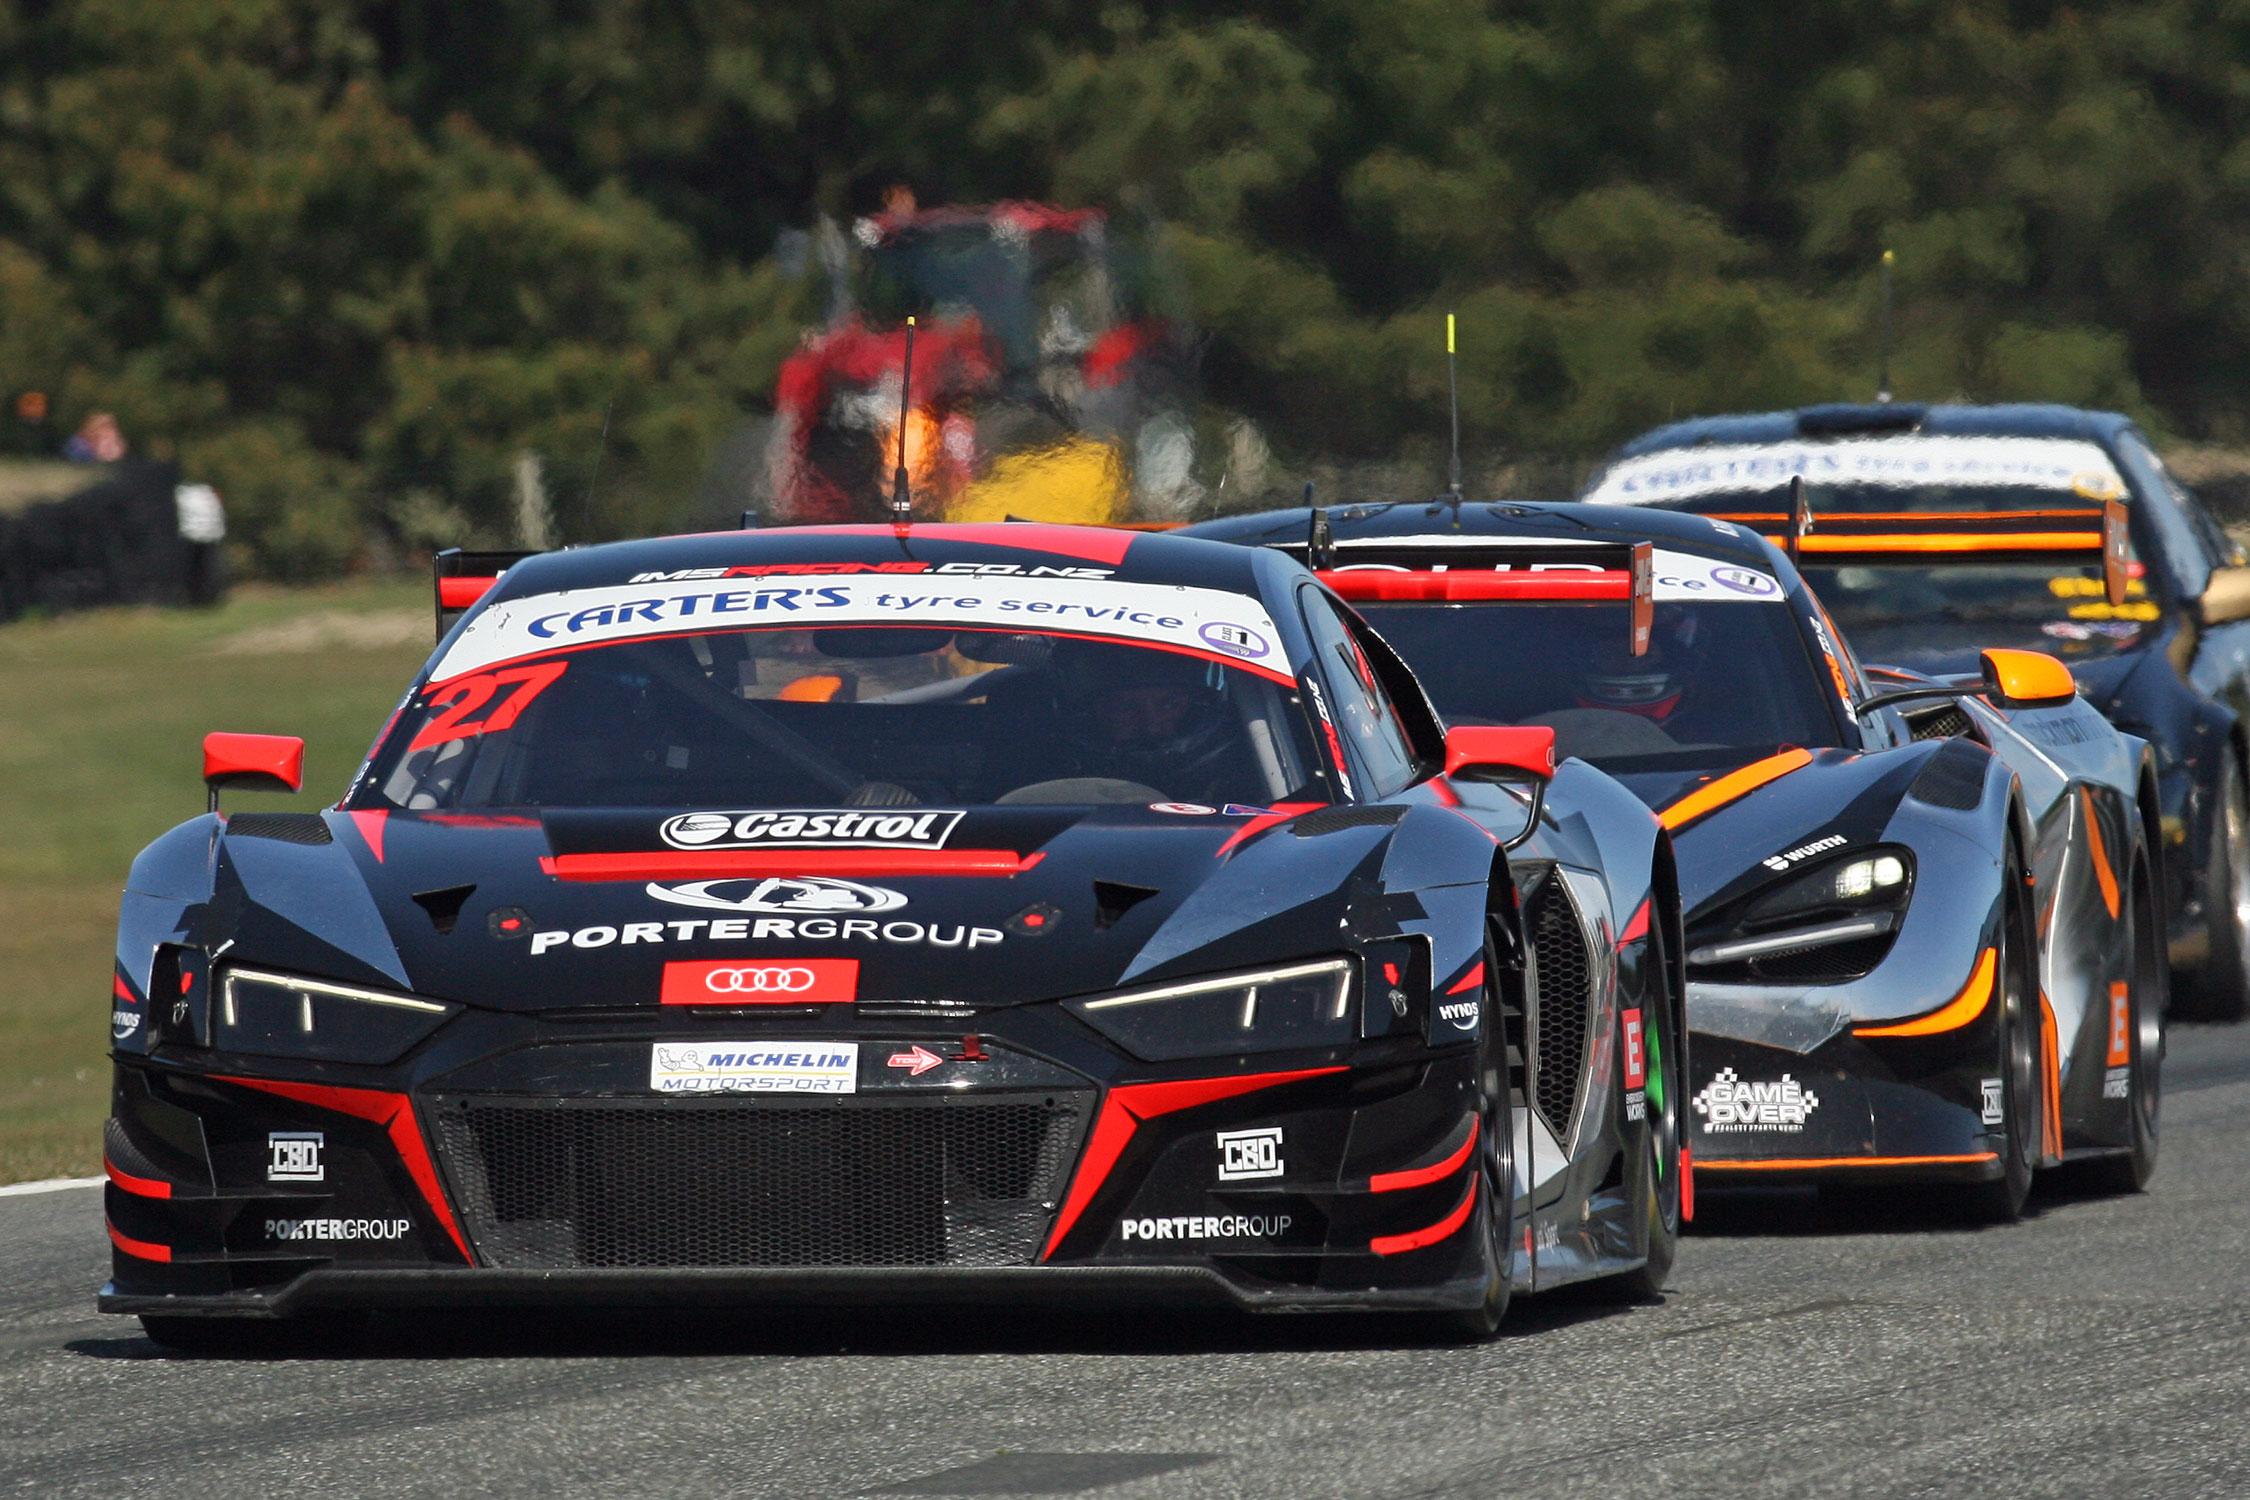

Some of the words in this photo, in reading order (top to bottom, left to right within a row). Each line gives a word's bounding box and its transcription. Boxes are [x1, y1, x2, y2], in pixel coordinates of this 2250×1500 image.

[527, 586, 851, 639] CARTER'S
[876, 591, 982, 610] tyre
[1000, 596, 1184, 629] service
[407, 660, 569, 753] 27
[732, 810, 932, 841] Castrol
[529, 917, 1005, 955] PORTERGROUP
[1438, 1001, 1479, 1020] HYNDS
[707, 1053, 851, 1068] MICHELIN
[1626, 1020, 1642, 1076] E
[662, 1077, 850, 1091] MOTORSPORT
[1708, 1082, 1801, 1104] GAME
[1708, 1103, 1806, 1124] OVER
[272, 1139, 319, 1174] CBD
[1224, 1136, 1278, 1173] CBD
[264, 1218, 411, 1240] PORTERGROUP
[1121, 1215, 1293, 1241] PORTERGROUP
